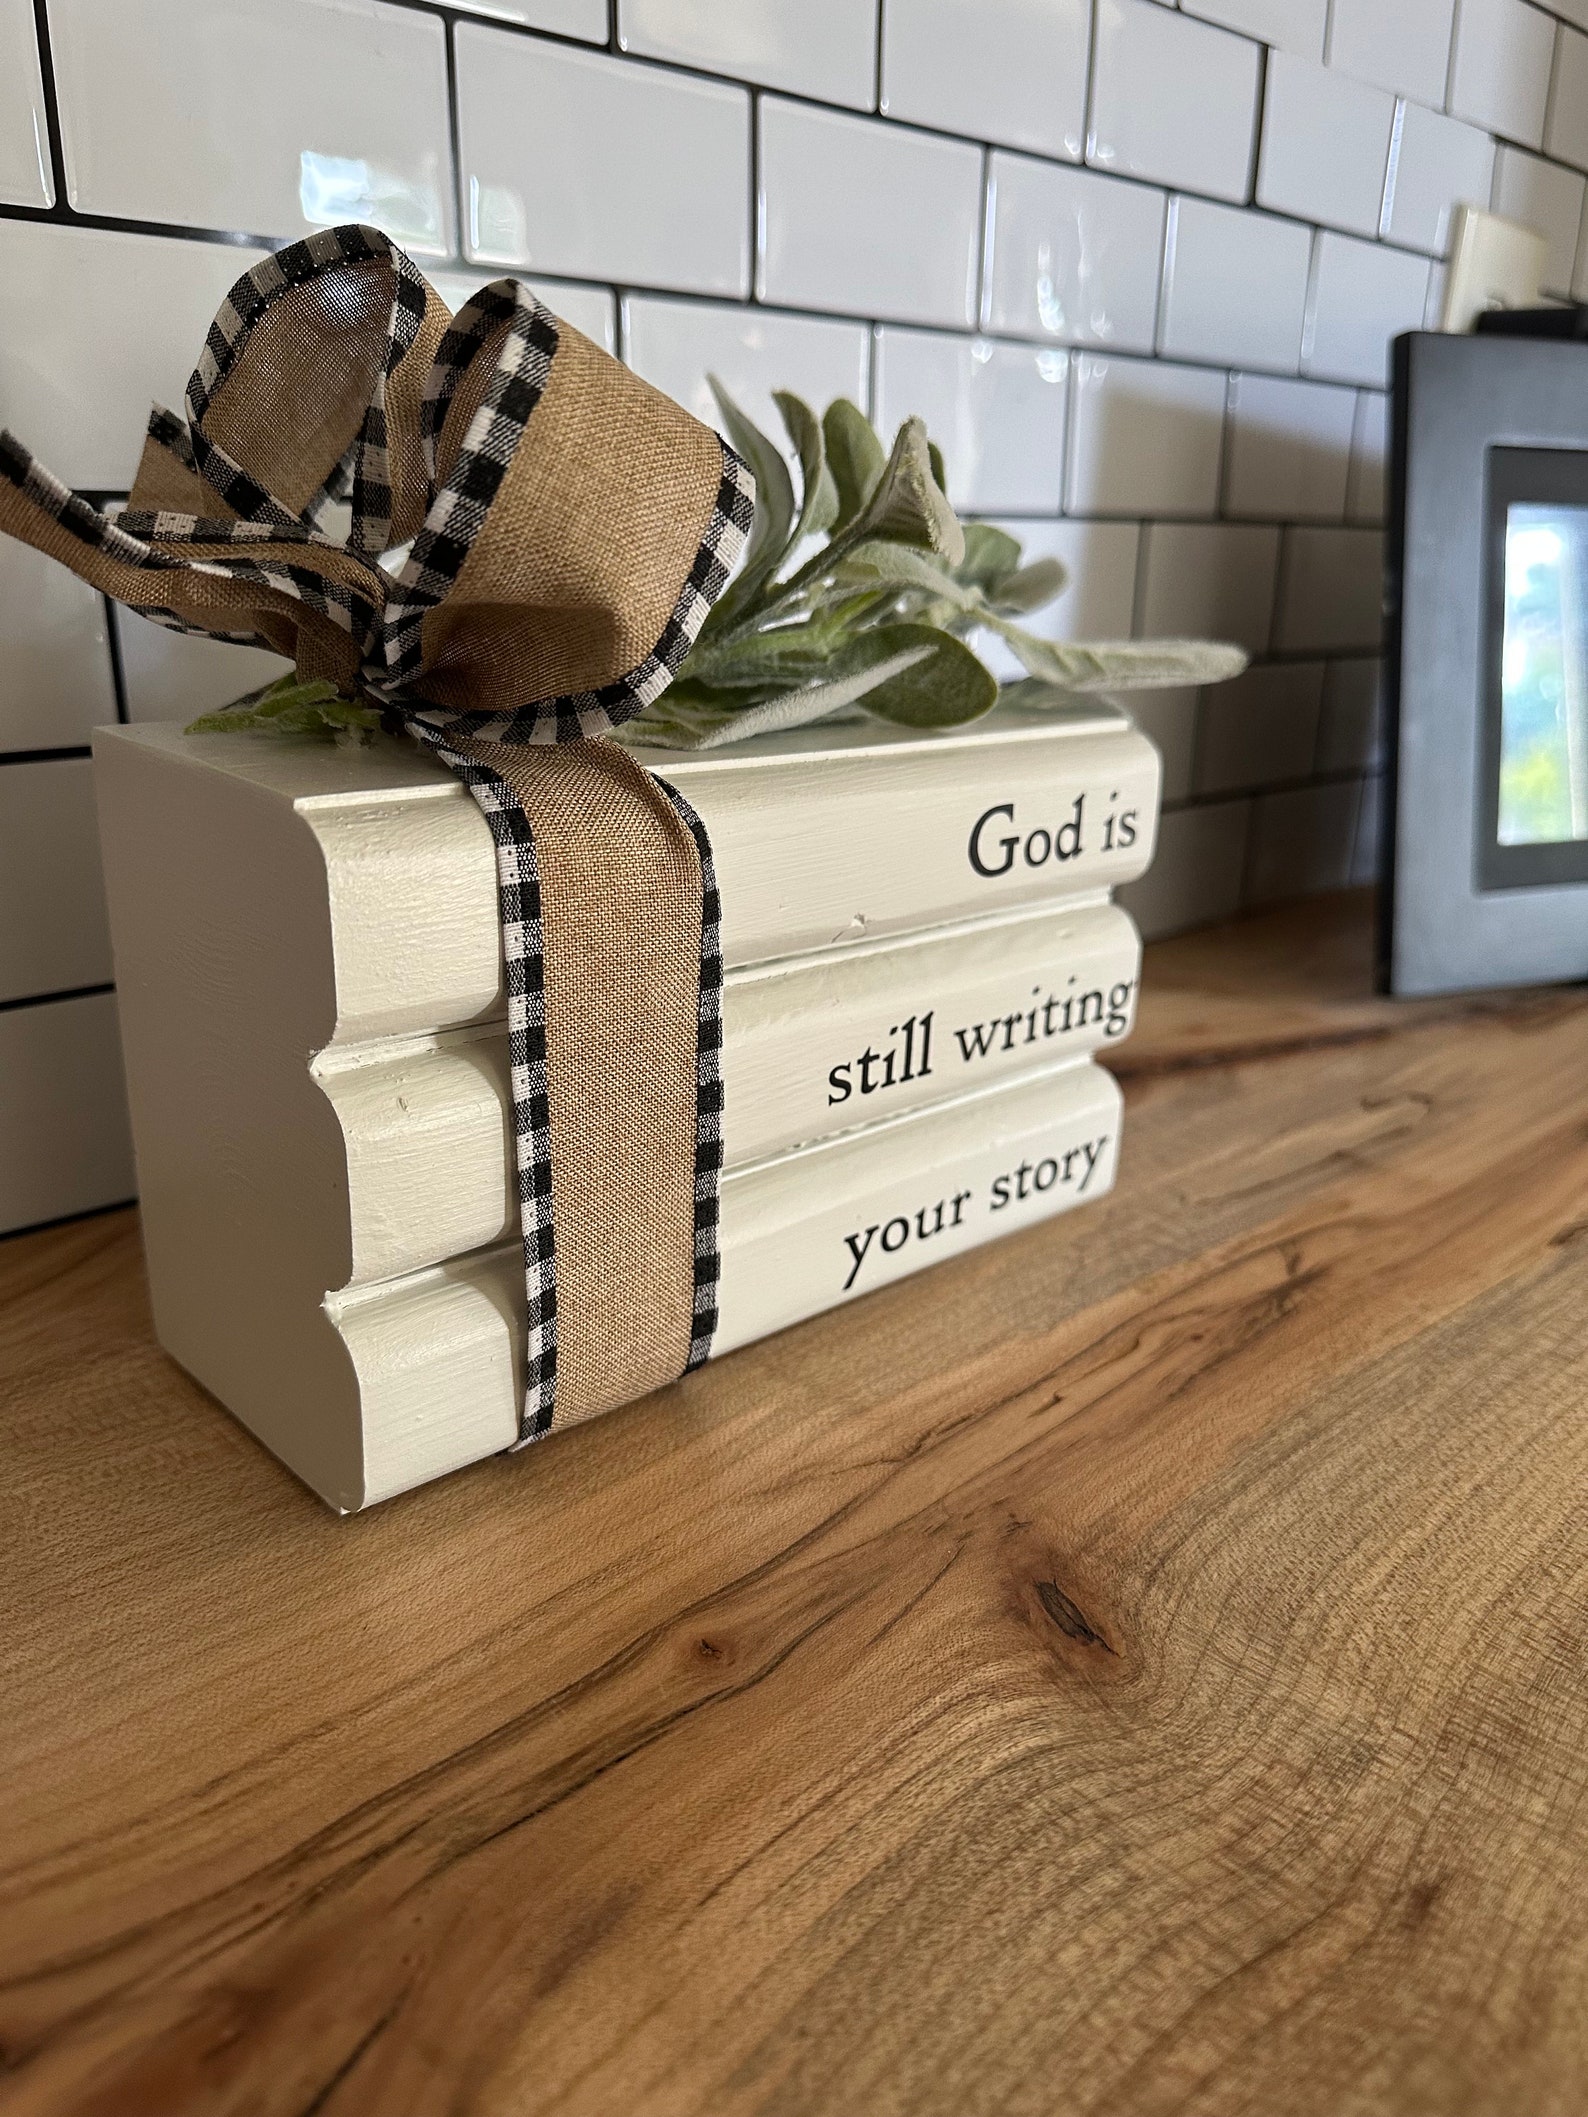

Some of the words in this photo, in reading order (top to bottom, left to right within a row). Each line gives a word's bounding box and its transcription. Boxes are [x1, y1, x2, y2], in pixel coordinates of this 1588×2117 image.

[967, 793, 1087, 878] God
[1102, 791, 1138, 852] is
[827, 1010, 935, 1107] still
[953, 975, 1138, 1062] writing
[843, 1188, 971, 1290] your
[989, 1135, 1110, 1211] story
